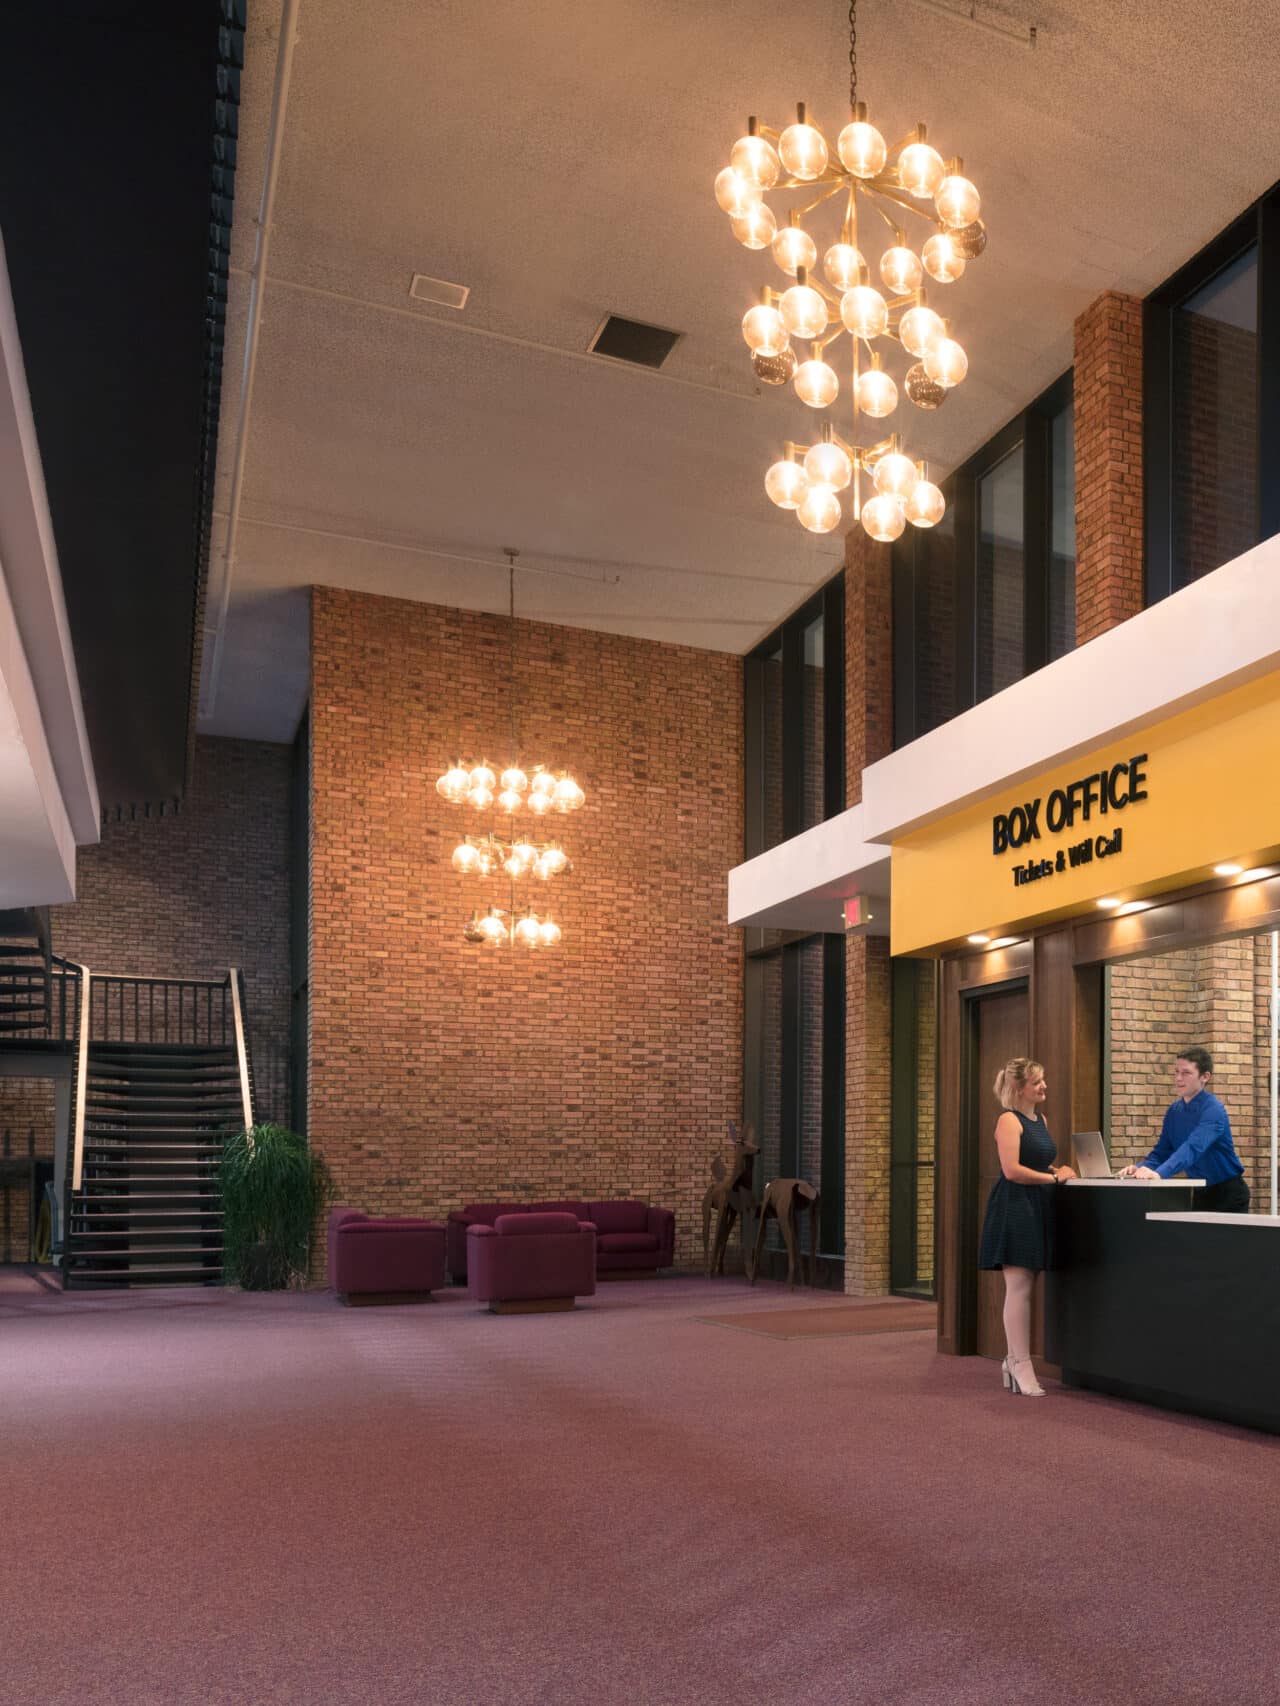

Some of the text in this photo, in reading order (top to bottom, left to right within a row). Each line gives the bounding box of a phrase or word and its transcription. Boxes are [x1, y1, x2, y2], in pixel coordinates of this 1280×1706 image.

[993, 754, 1148, 855] BOX OFFICE
[1012, 828, 1122, 887] Tickets & Will Call
